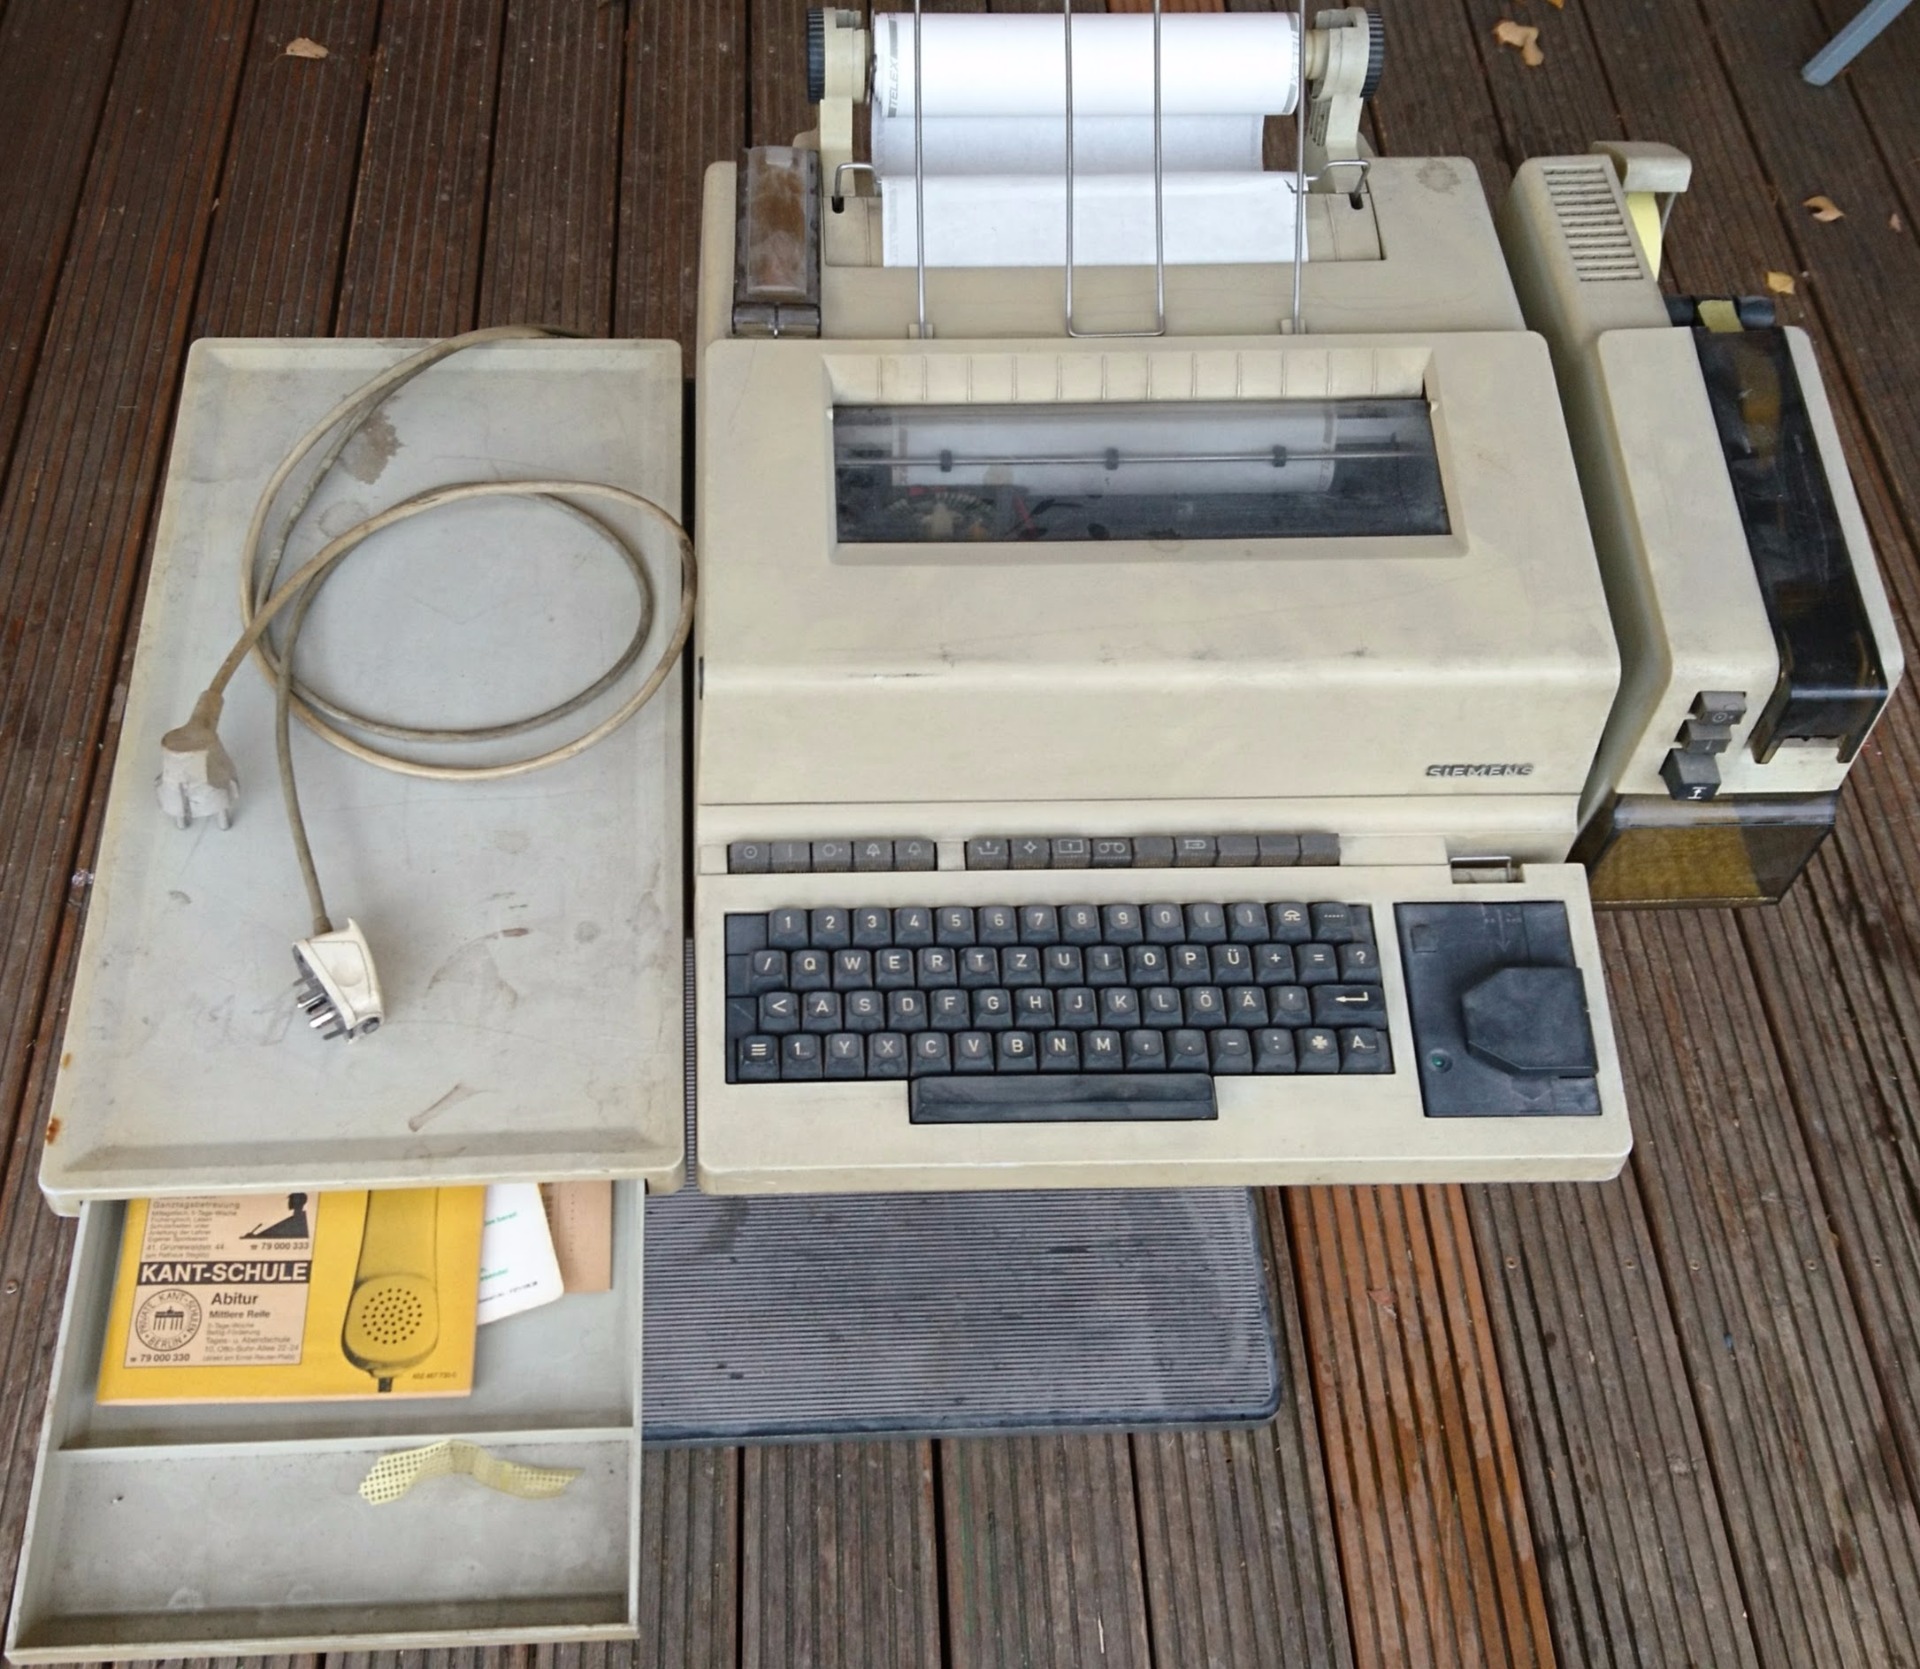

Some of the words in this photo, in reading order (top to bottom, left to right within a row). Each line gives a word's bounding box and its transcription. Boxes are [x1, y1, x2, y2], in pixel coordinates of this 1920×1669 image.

[1425, 763, 1534, 777] SIEMENS
[825, 915, 835, 929] 2
[867, 914, 877, 928] 3
[909, 914, 920, 927] 4
[951, 913, 961, 927] 5
[993, 912, 1004, 927] 6
[1034, 912, 1044, 926] 7
[1077, 911, 1087, 925] 8
[1117, 911, 1129, 925] 9
[803, 957, 816, 971] Q
[844, 956, 862, 970] W
[888, 955, 900, 969] E
[931, 954, 943, 968] R
[974, 954, 984, 967] T
[1015, 953, 1027, 968] Z
[1057, 952, 1070, 967] U
[1184, 951, 1197, 965] P
[1227, 948, 1240, 965] Ü
[815, 999, 829, 1013] A
[859, 997, 871, 1012] S
[901, 997, 914, 1012] D
[943, 996, 956, 1010] F
[987, 995, 999, 1010] G
[1029, 995, 1042, 1009] H
[1074, 995, 1083, 1009] J
[1114, 995, 1127, 1008] K
[1157, 994, 1169, 1008] L
[1199, 990, 1212, 1008] Ö
[1242, 990, 1256, 1007] Ä
[838, 1040, 851, 1055] Y
[882, 1040, 894, 1054] X
[925, 1039, 937, 1054] C
[967, 1039, 980, 1053] V
[1011, 1038, 1024, 1053] B
[1053, 1037, 1067, 1052] N
[1096, 1037, 1111, 1051] M
[274, 1242, 291, 1250] 000
[140, 1262, 309, 1283] KANT-SCHULE
[211, 1292, 259, 1306] Abitur
[209, 1310, 245, 1319] Mittlere
[153, 1353, 171, 1362] 000
[173, 1353, 190, 1362] 330
